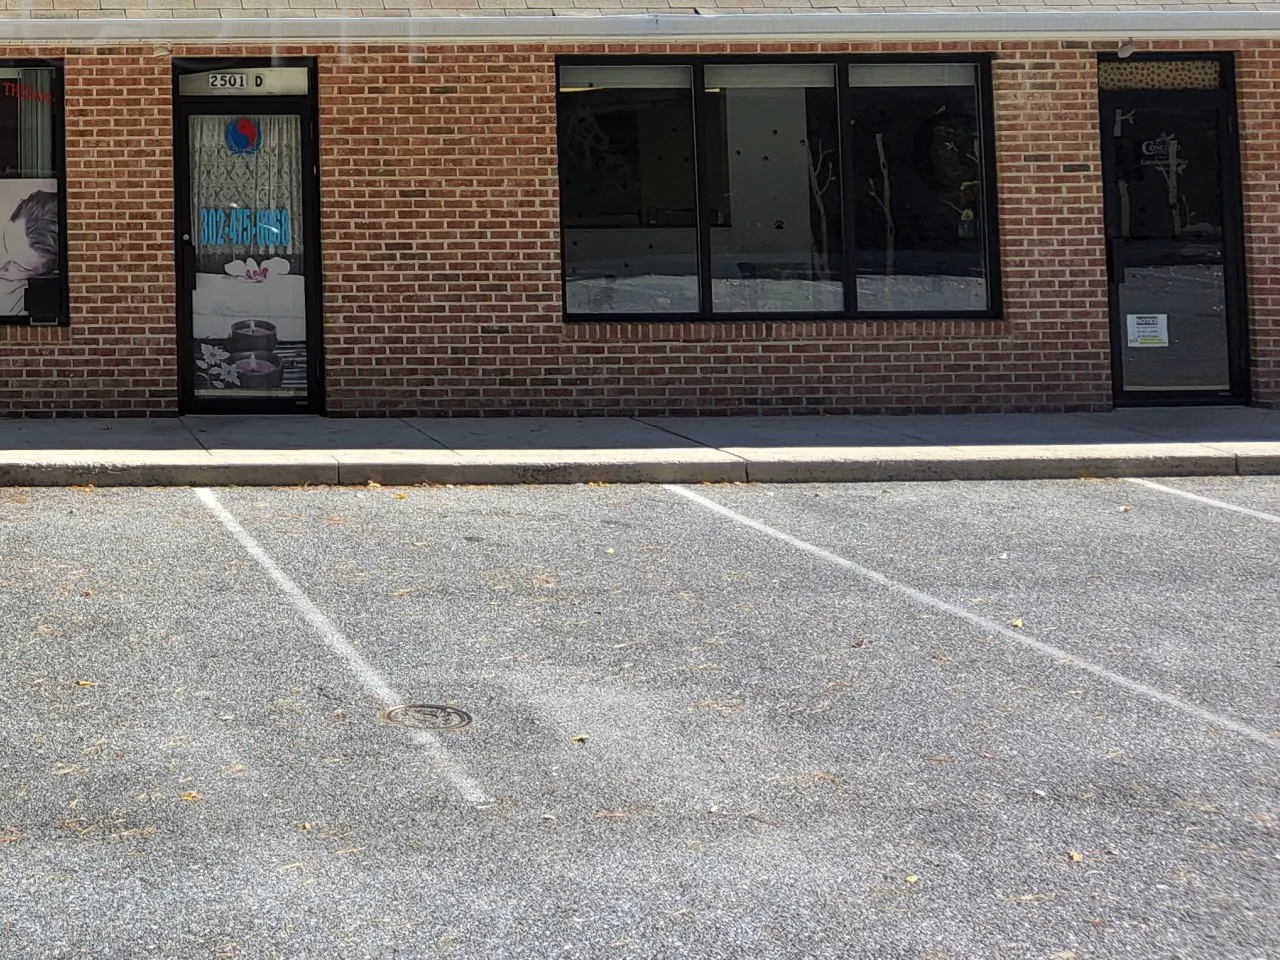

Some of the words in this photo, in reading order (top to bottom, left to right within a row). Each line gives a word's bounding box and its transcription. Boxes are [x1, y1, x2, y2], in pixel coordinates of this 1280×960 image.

[2, 81, 53, 107] THERAPY
[210, 75, 245, 87] 2501
[254, 75, 263, 87] D
[200, 208, 289, 246] 302-475-6868
